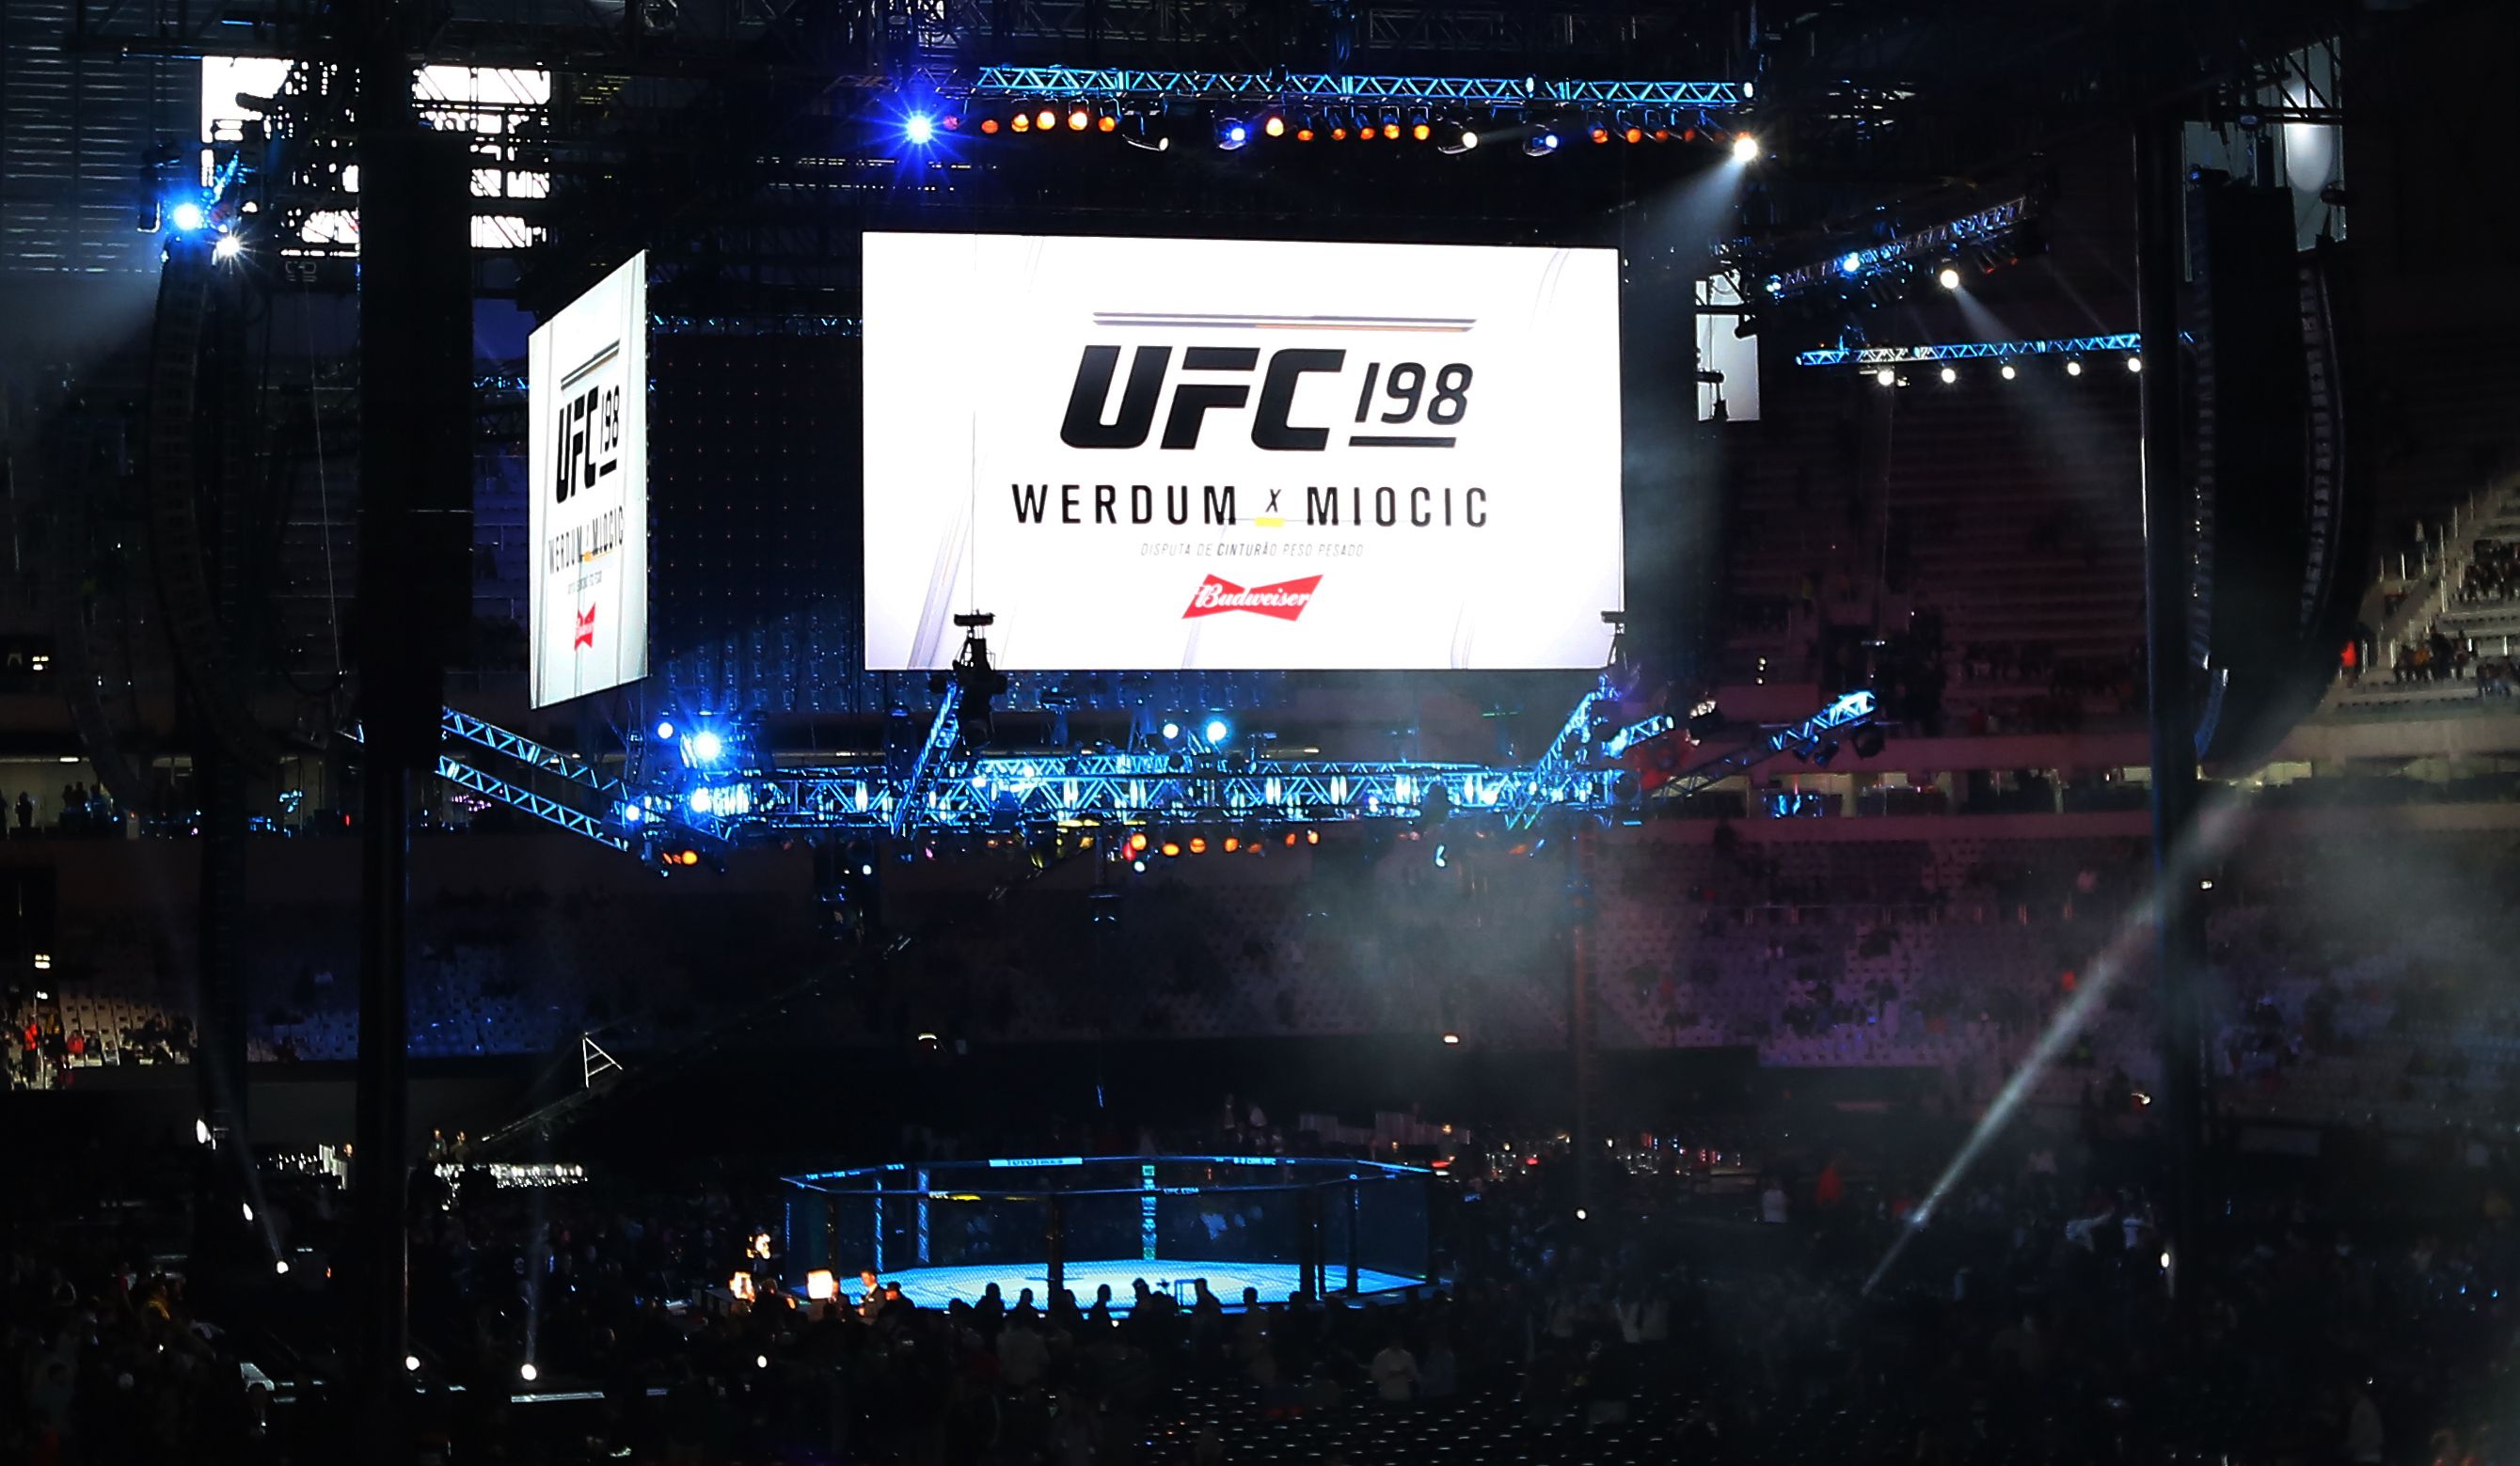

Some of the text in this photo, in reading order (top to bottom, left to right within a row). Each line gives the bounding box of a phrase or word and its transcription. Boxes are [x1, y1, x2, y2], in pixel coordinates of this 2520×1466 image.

[1060, 344, 1474, 451] UFC 198
[556, 384, 620, 504] UFC 198
[1011, 483, 1237, 526] WERDUM
[1307, 486, 1486, 528] MIOCIC
[592, 505, 624, 556] MIOCIC
[1140, 541, 1364, 558] DISPUTA DE CINTURÃO PESO PESADO
[1194, 583, 1311, 608] Budweiser
